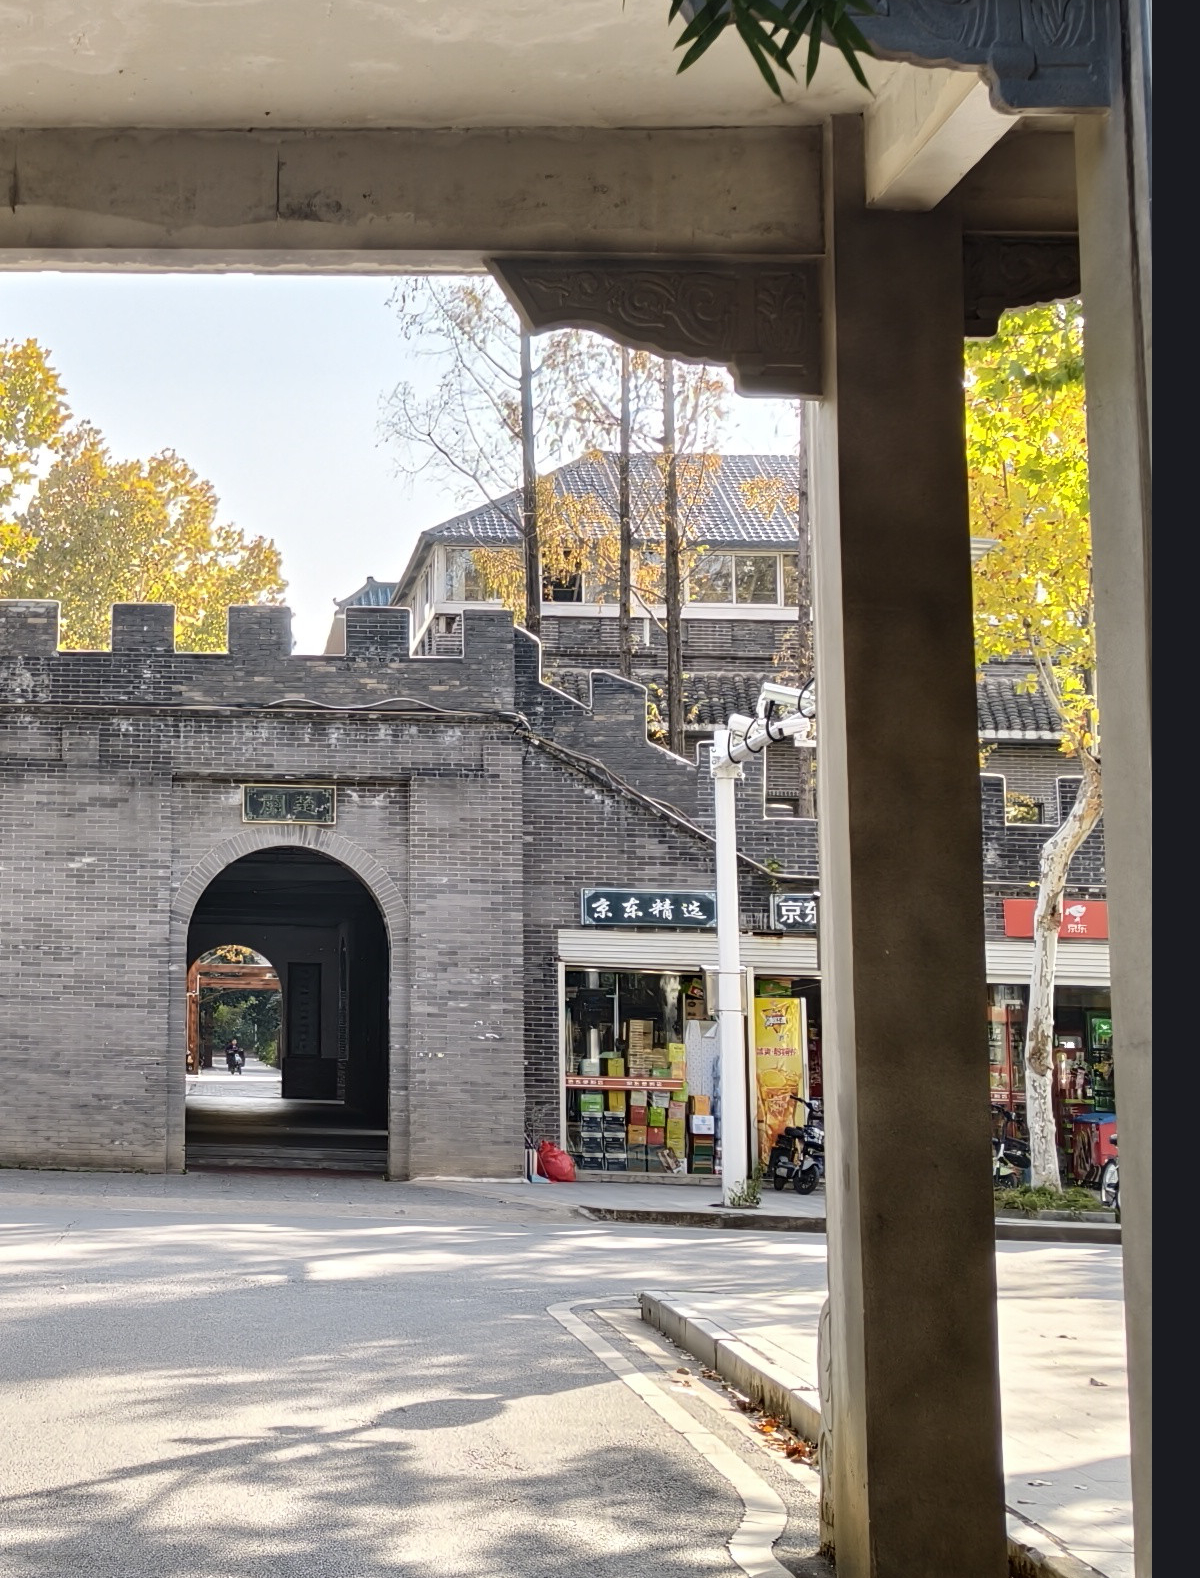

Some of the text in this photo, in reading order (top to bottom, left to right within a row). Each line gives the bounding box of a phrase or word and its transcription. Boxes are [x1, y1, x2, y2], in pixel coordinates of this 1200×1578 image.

[591, 897, 707, 921] 京东精选
[1067, 924, 1088, 933] 京东
